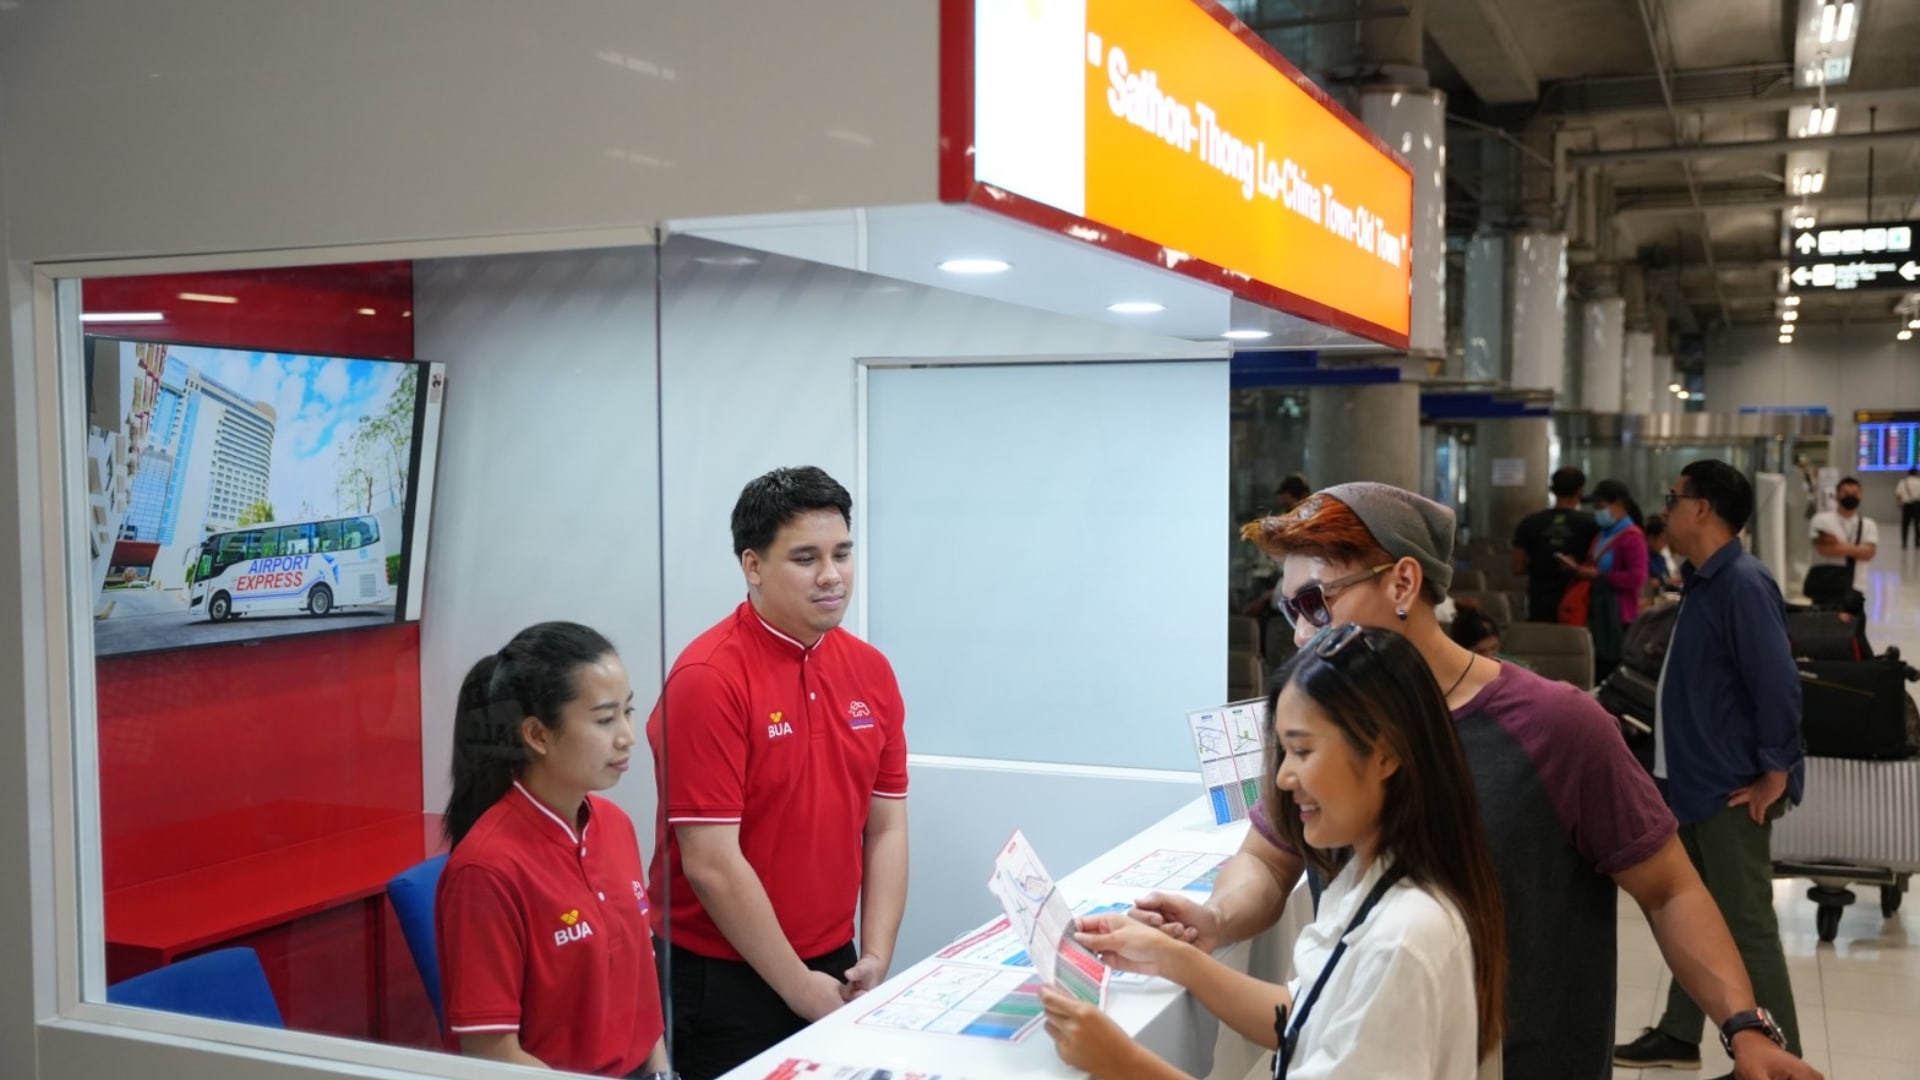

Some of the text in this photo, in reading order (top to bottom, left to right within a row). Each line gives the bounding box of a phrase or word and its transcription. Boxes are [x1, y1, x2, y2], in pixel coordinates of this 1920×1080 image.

[1258, 141, 1321, 224] Lo-China
[248, 555, 313, 574] AIRPORT
[236, 571, 303, 591] EXPRESS
[768, 721, 793, 739] BUA
[554, 920, 594, 947] BUA
